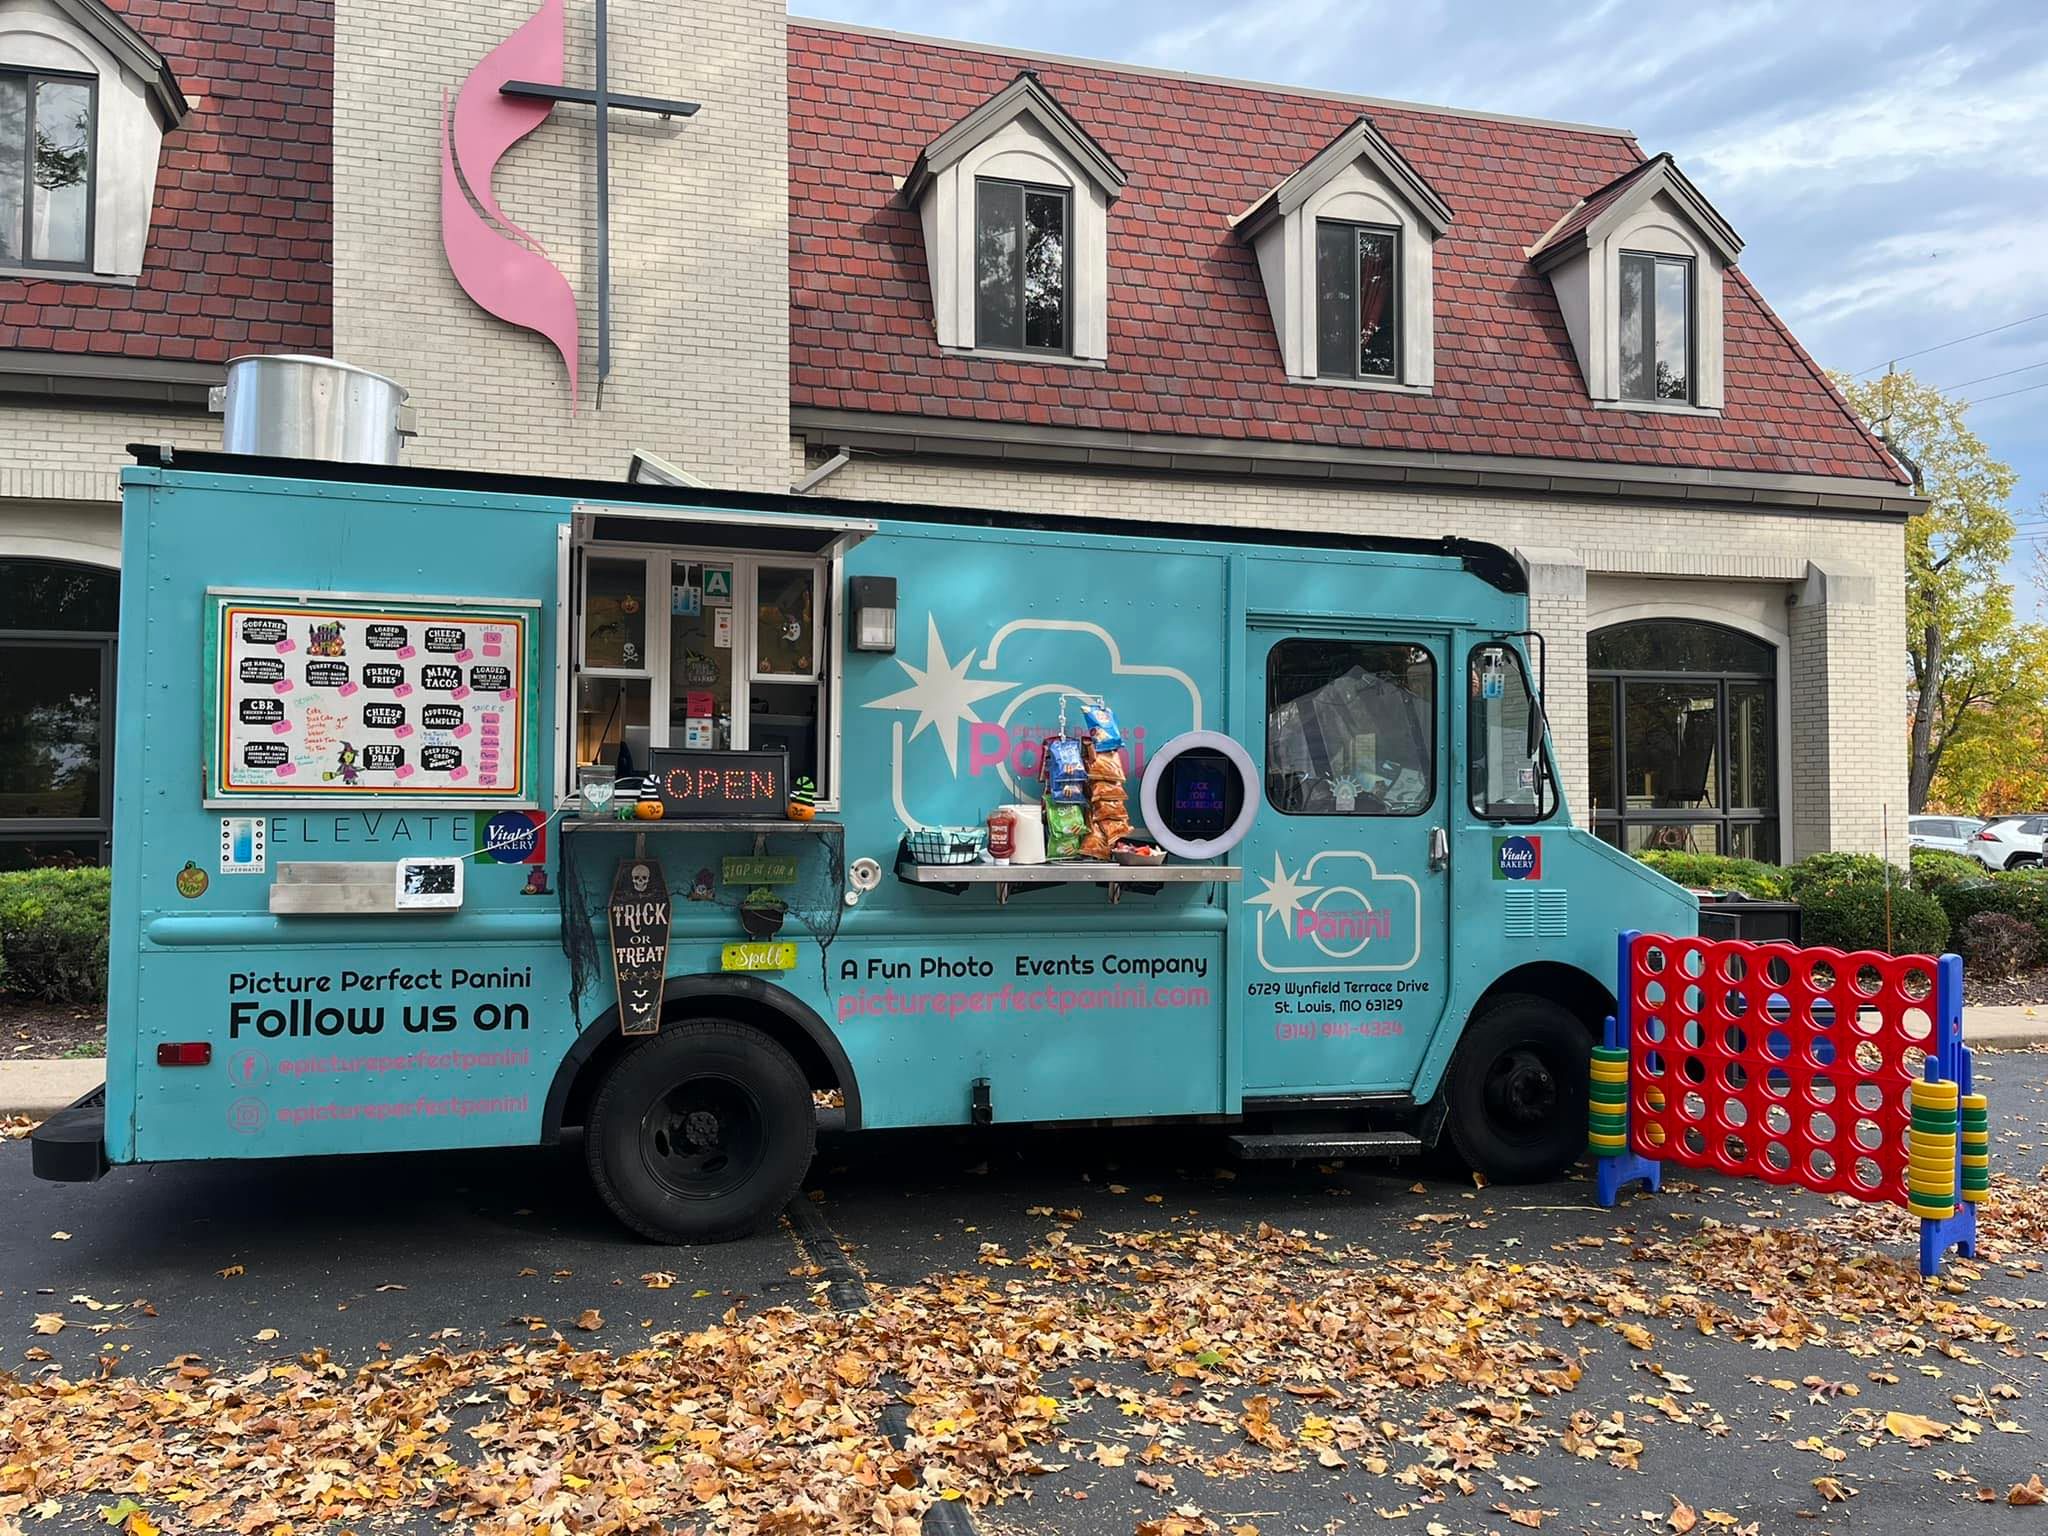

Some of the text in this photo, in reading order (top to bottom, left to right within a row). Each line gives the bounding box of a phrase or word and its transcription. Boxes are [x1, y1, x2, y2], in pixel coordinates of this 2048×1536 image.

[706, 572, 728, 593] A
[243, 621, 287, 630] GODFATHER
[374, 626, 399, 634] LOADED
[429, 630, 462, 638] CHEESE
[366, 668, 402, 677] FRENCH
[426, 667, 457, 679] MINI
[372, 676, 397, 684] FRIES
[425, 678, 459, 688] TACOS
[251, 701, 274, 710] CBR
[366, 708, 403, 718] CHEESE
[424, 709, 462, 718] APPETIZER
[372, 716, 398, 725] FRIES
[424, 717, 460, 725] SAMPLER
[368, 746, 400, 755] FRIED
[424, 748, 460, 756] DEEP FRIED
[969, 722, 1145, 777] Pai
[372, 754, 395, 762] PB&J
[430, 758, 455, 768] DONUTS
[664, 768, 776, 799] OPEN
[271, 812, 469, 843] ELEVATE
[488, 824, 534, 841] Vitale's
[487, 840, 536, 850] BAKERY
[1502, 848, 1532, 860] Vitale's
[1500, 860, 1534, 869] BAKERY
[724, 864, 750, 878] STOP
[612, 902, 668, 933] TRICK
[1297, 907, 1393, 940] Panini
[630, 935, 651, 944] OR
[616, 946, 665, 968] TREAT
[735, 944, 784, 970] Spell
[840, 954, 1208, 980] A Fun Photo Events Company
[229, 966, 532, 994] Picture Perfect Panini
[1247, 979, 1430, 998] 6729 Wynfield Terrace Drive
[838, 981, 1210, 1022] pictureperfectpanini.com
[1274, 999, 1404, 1014] St. Louis, MO 63129
[229, 998, 530, 1039] Follow us on
[1274, 1022, 1317, 1041] (314)
[278, 1048, 529, 1077] @pictureperfectpanini
[277, 1096, 528, 1124] @pictureperfectpanini
